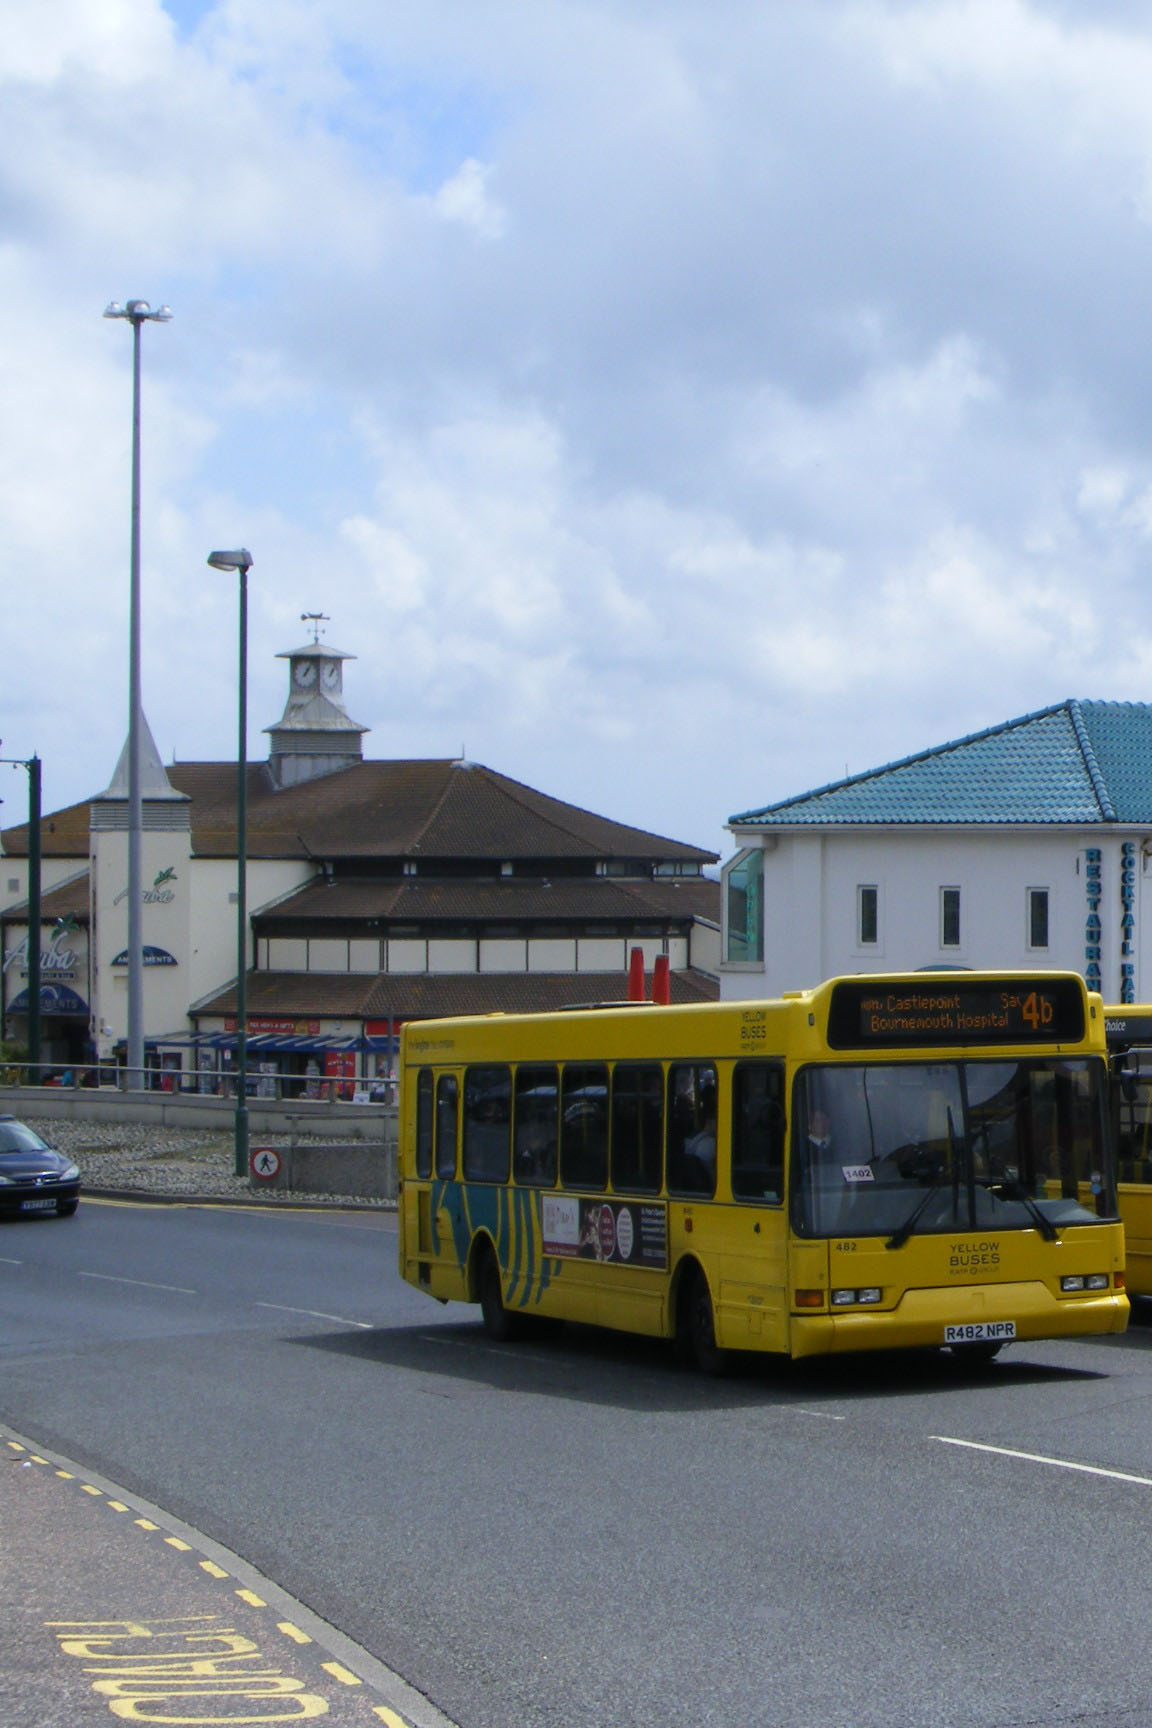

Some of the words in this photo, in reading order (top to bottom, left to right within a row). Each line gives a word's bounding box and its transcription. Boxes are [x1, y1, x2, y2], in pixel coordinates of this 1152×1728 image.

[1120, 842, 1135, 956] COCKTAIL
[886, 995, 961, 1012] Castlepoint
[1022, 991, 1054, 1030] 4b
[871, 1013, 953, 1032] Bournemouth
[957, 1012, 1009, 1029] Hospital
[1104, 1018, 1127, 1031] hoice
[741, 1025, 766, 1039] BUSES
[846, 1169, 872, 1178] 1402
[836, 1243, 857, 1251] 482
[950, 1242, 1000, 1254] YELLOW
[949, 1253, 1001, 1267] BUSES
[946, 1325, 984, 1340] R482
[987, 1322, 1014, 1337] NPR
[44, 1615, 330, 1725] COACH
